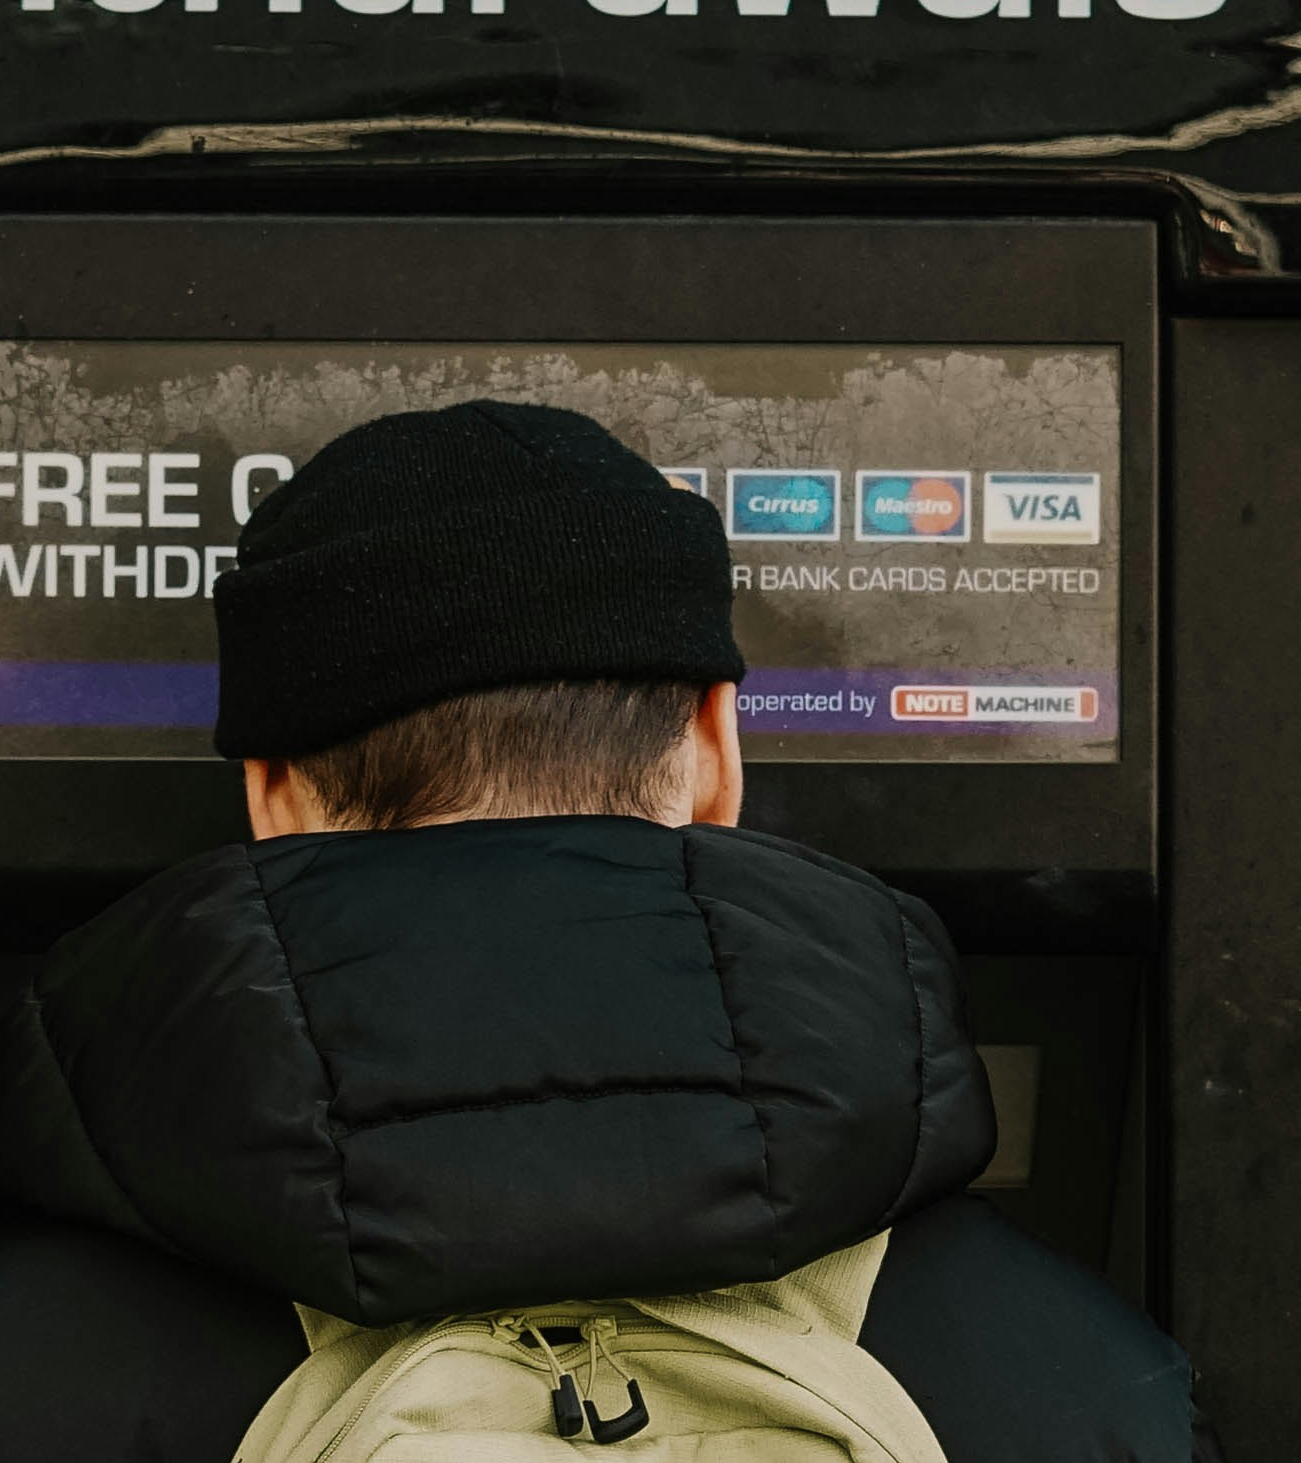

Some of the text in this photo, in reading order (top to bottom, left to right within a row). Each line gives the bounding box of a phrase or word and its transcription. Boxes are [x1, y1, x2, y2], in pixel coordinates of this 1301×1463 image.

[749, 495, 819, 514] Cirrus
[874, 497, 953, 516] Maestro
[1005, 495, 1082, 521] VISA
[760, 566, 841, 591] BANK
[849, 567, 946, 592] CARDS
[953, 568, 1100, 594] ACCEPTED
[737, 689, 876, 717] operated by
[905, 693, 1075, 714] NOTE MACHINE
